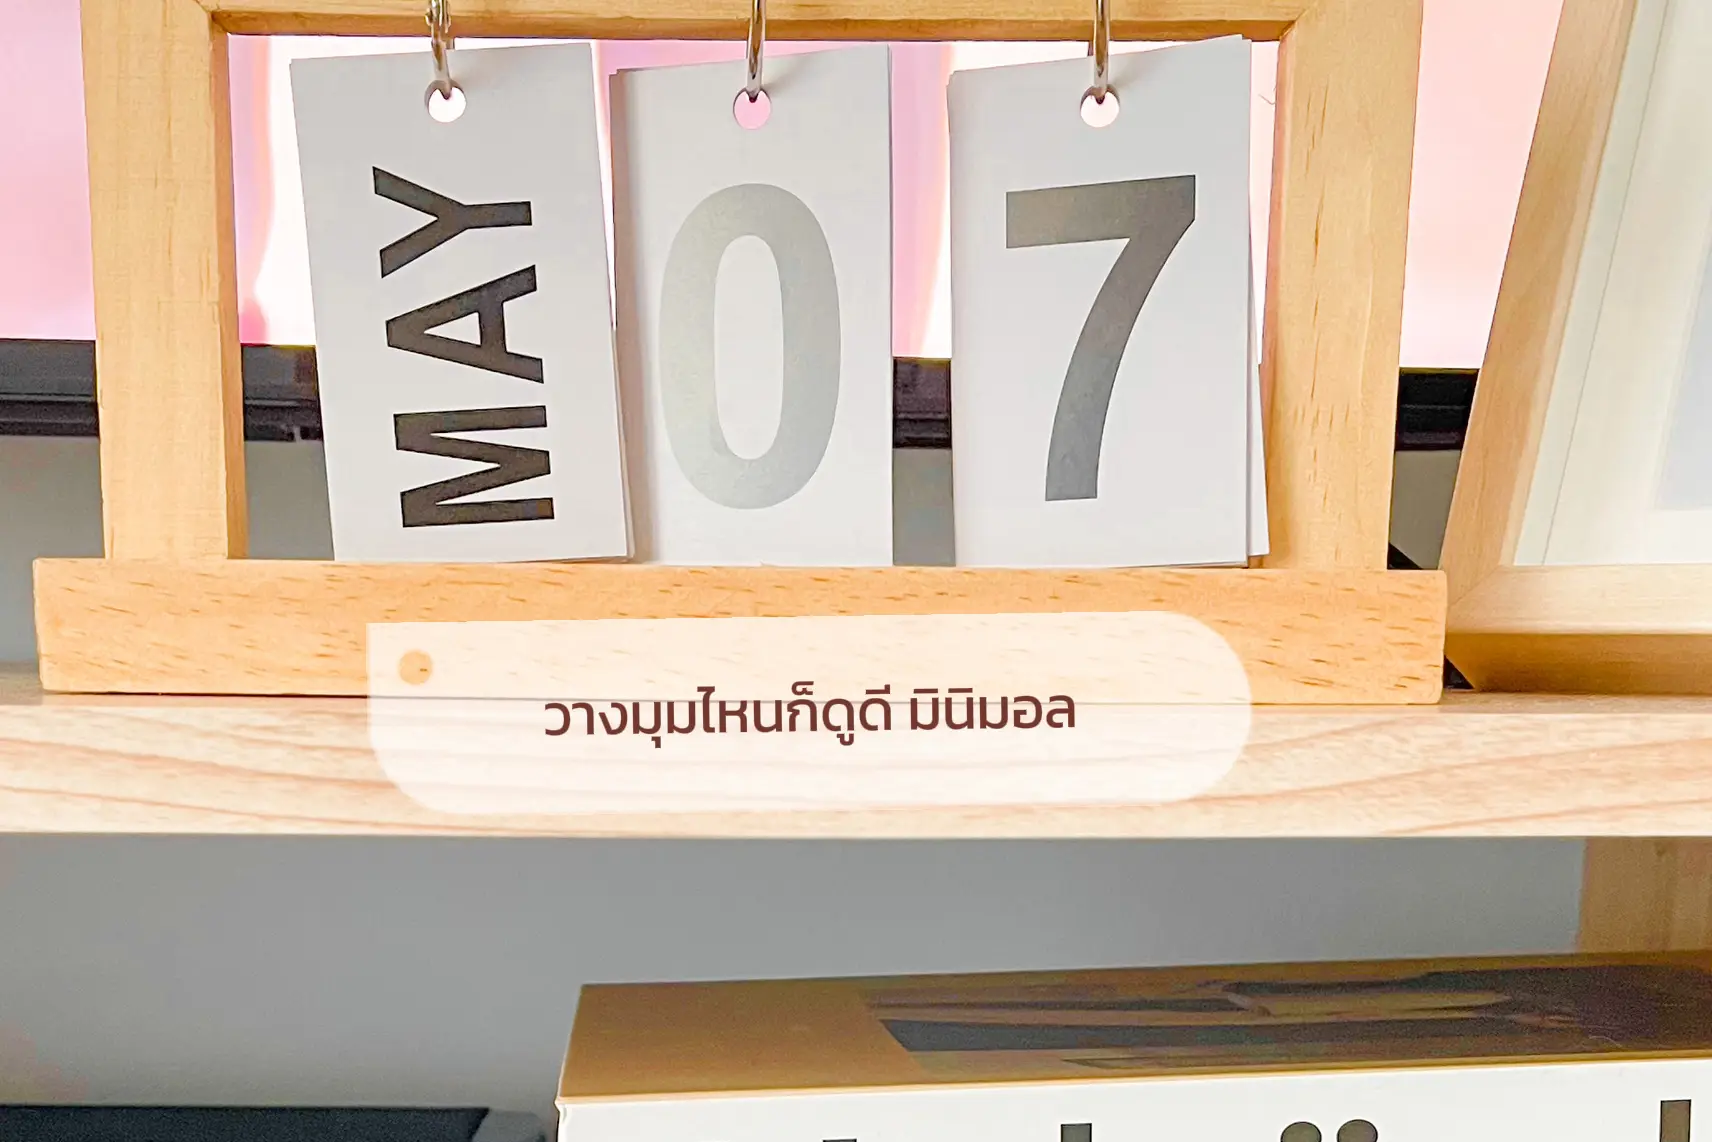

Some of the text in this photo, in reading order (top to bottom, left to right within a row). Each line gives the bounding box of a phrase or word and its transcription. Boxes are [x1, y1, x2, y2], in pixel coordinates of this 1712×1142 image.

[371, 165, 555, 528] MAY
[659, 183, 841, 509] 0
[1005, 174, 1197, 502] 7
